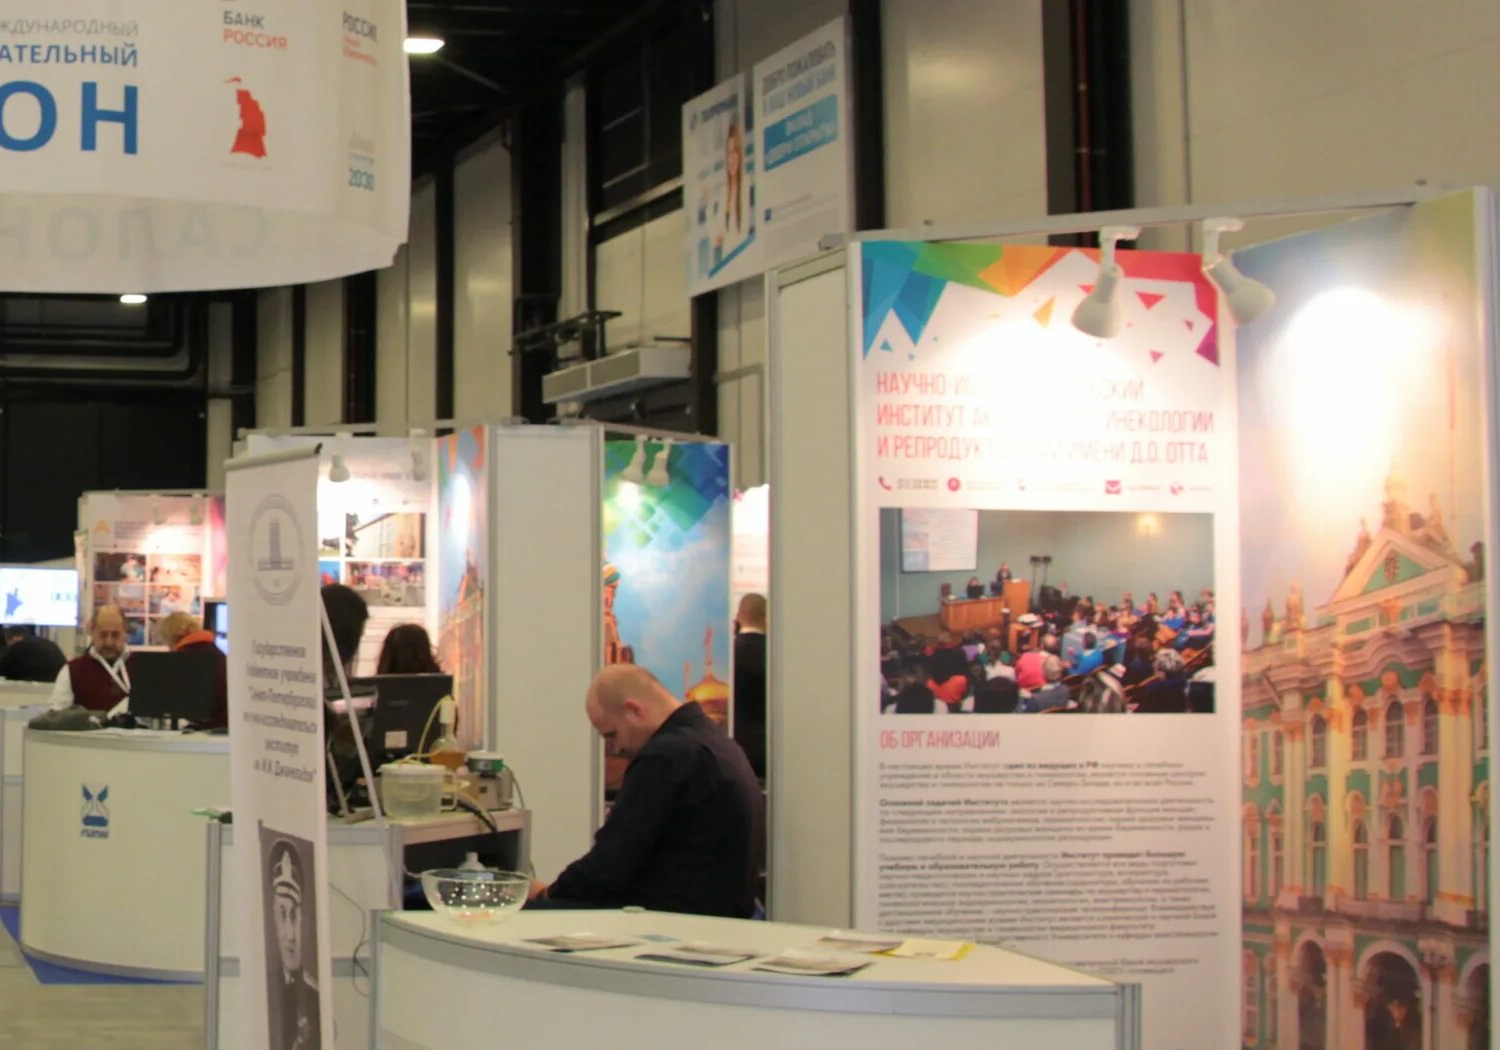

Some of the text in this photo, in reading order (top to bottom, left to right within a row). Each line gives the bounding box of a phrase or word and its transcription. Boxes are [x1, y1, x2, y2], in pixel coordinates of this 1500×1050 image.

[223, 10, 265, 30] БАНК
[223, 29, 288, 50] РОССИЯ
[876, 403, 965, 428] ИНСТИТУТ
[1104, 409, 1215, 433] ИНЕКОЛОГИИ
[876, 436, 890, 458] И
[1130, 442, 1162, 464] Д.О.
[1166, 442, 1208, 463] ОТТА
[880, 731, 1001, 749] ОБ ОРГАНИЗАЦИИ
